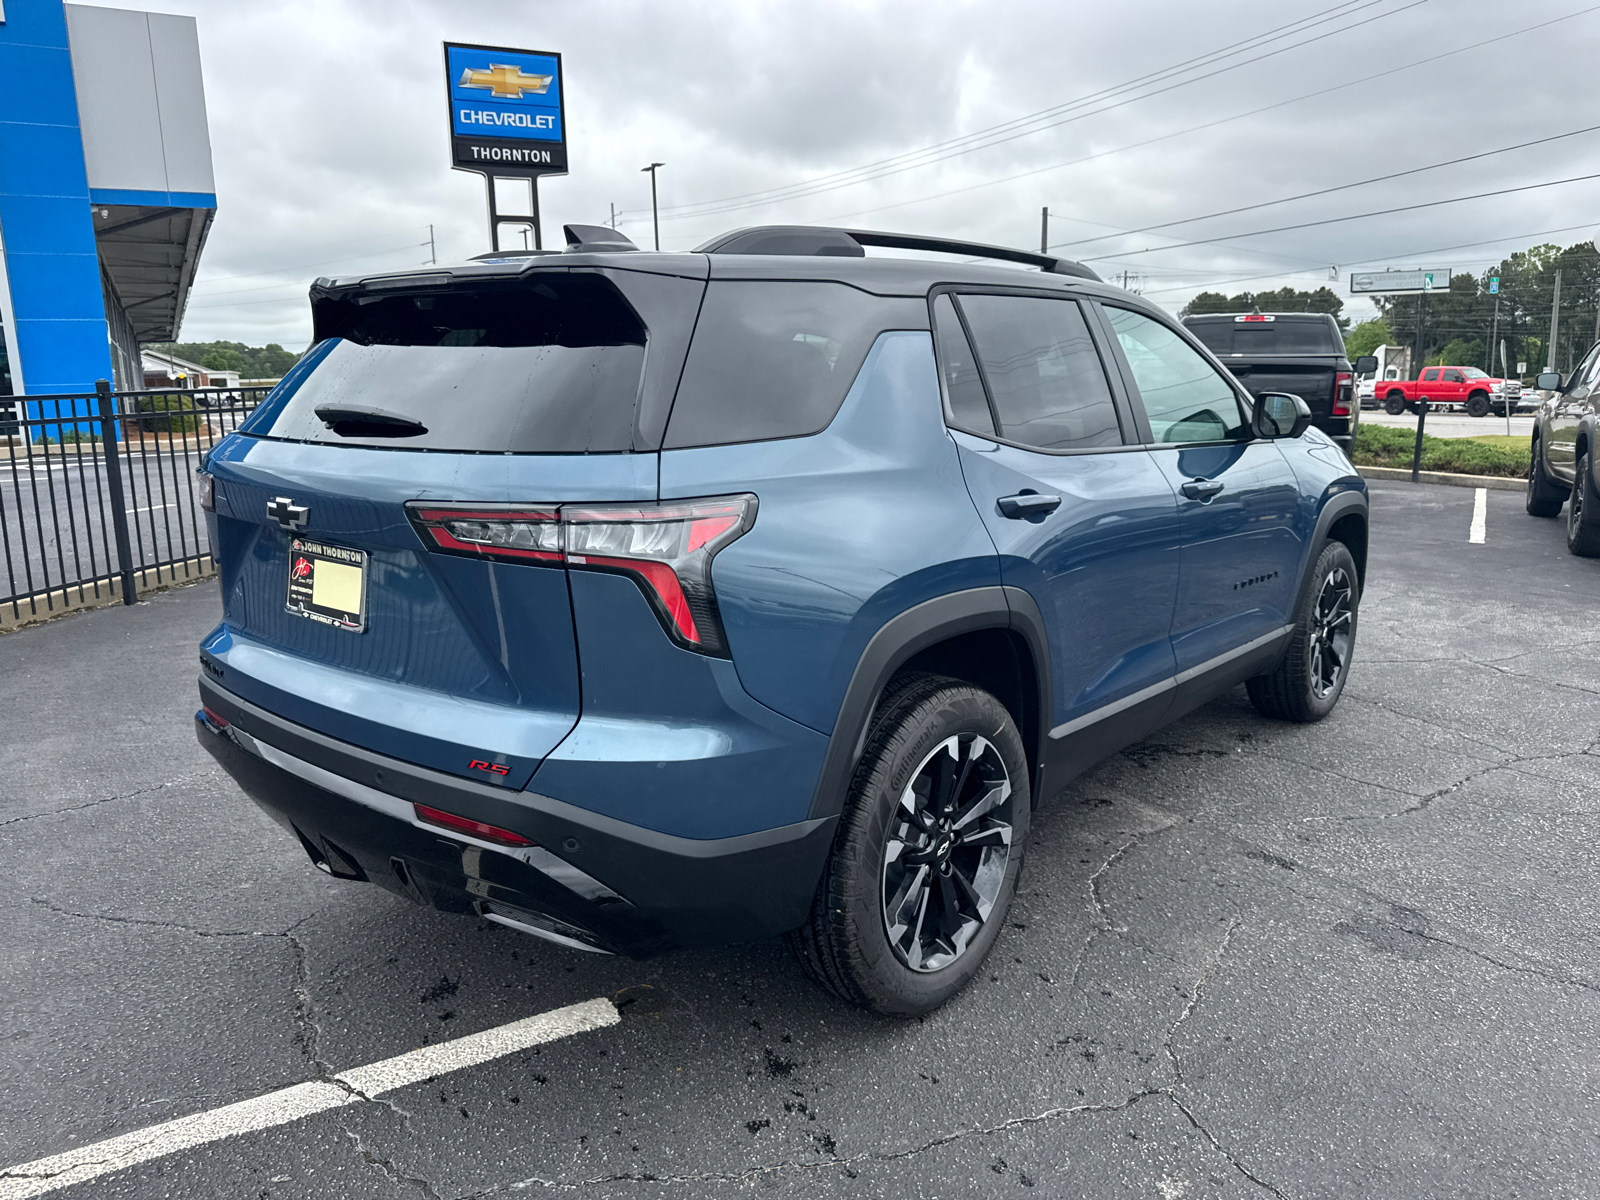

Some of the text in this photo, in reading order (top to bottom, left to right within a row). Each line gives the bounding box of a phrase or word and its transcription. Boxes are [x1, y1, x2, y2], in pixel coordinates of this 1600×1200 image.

[460, 109, 555, 129] CHEVROLET
[471, 146, 551, 163] THORNTON
[304, 541, 322, 554] JOHN
[890, 725, 933, 792] Continental
[469, 759, 511, 776] RS
